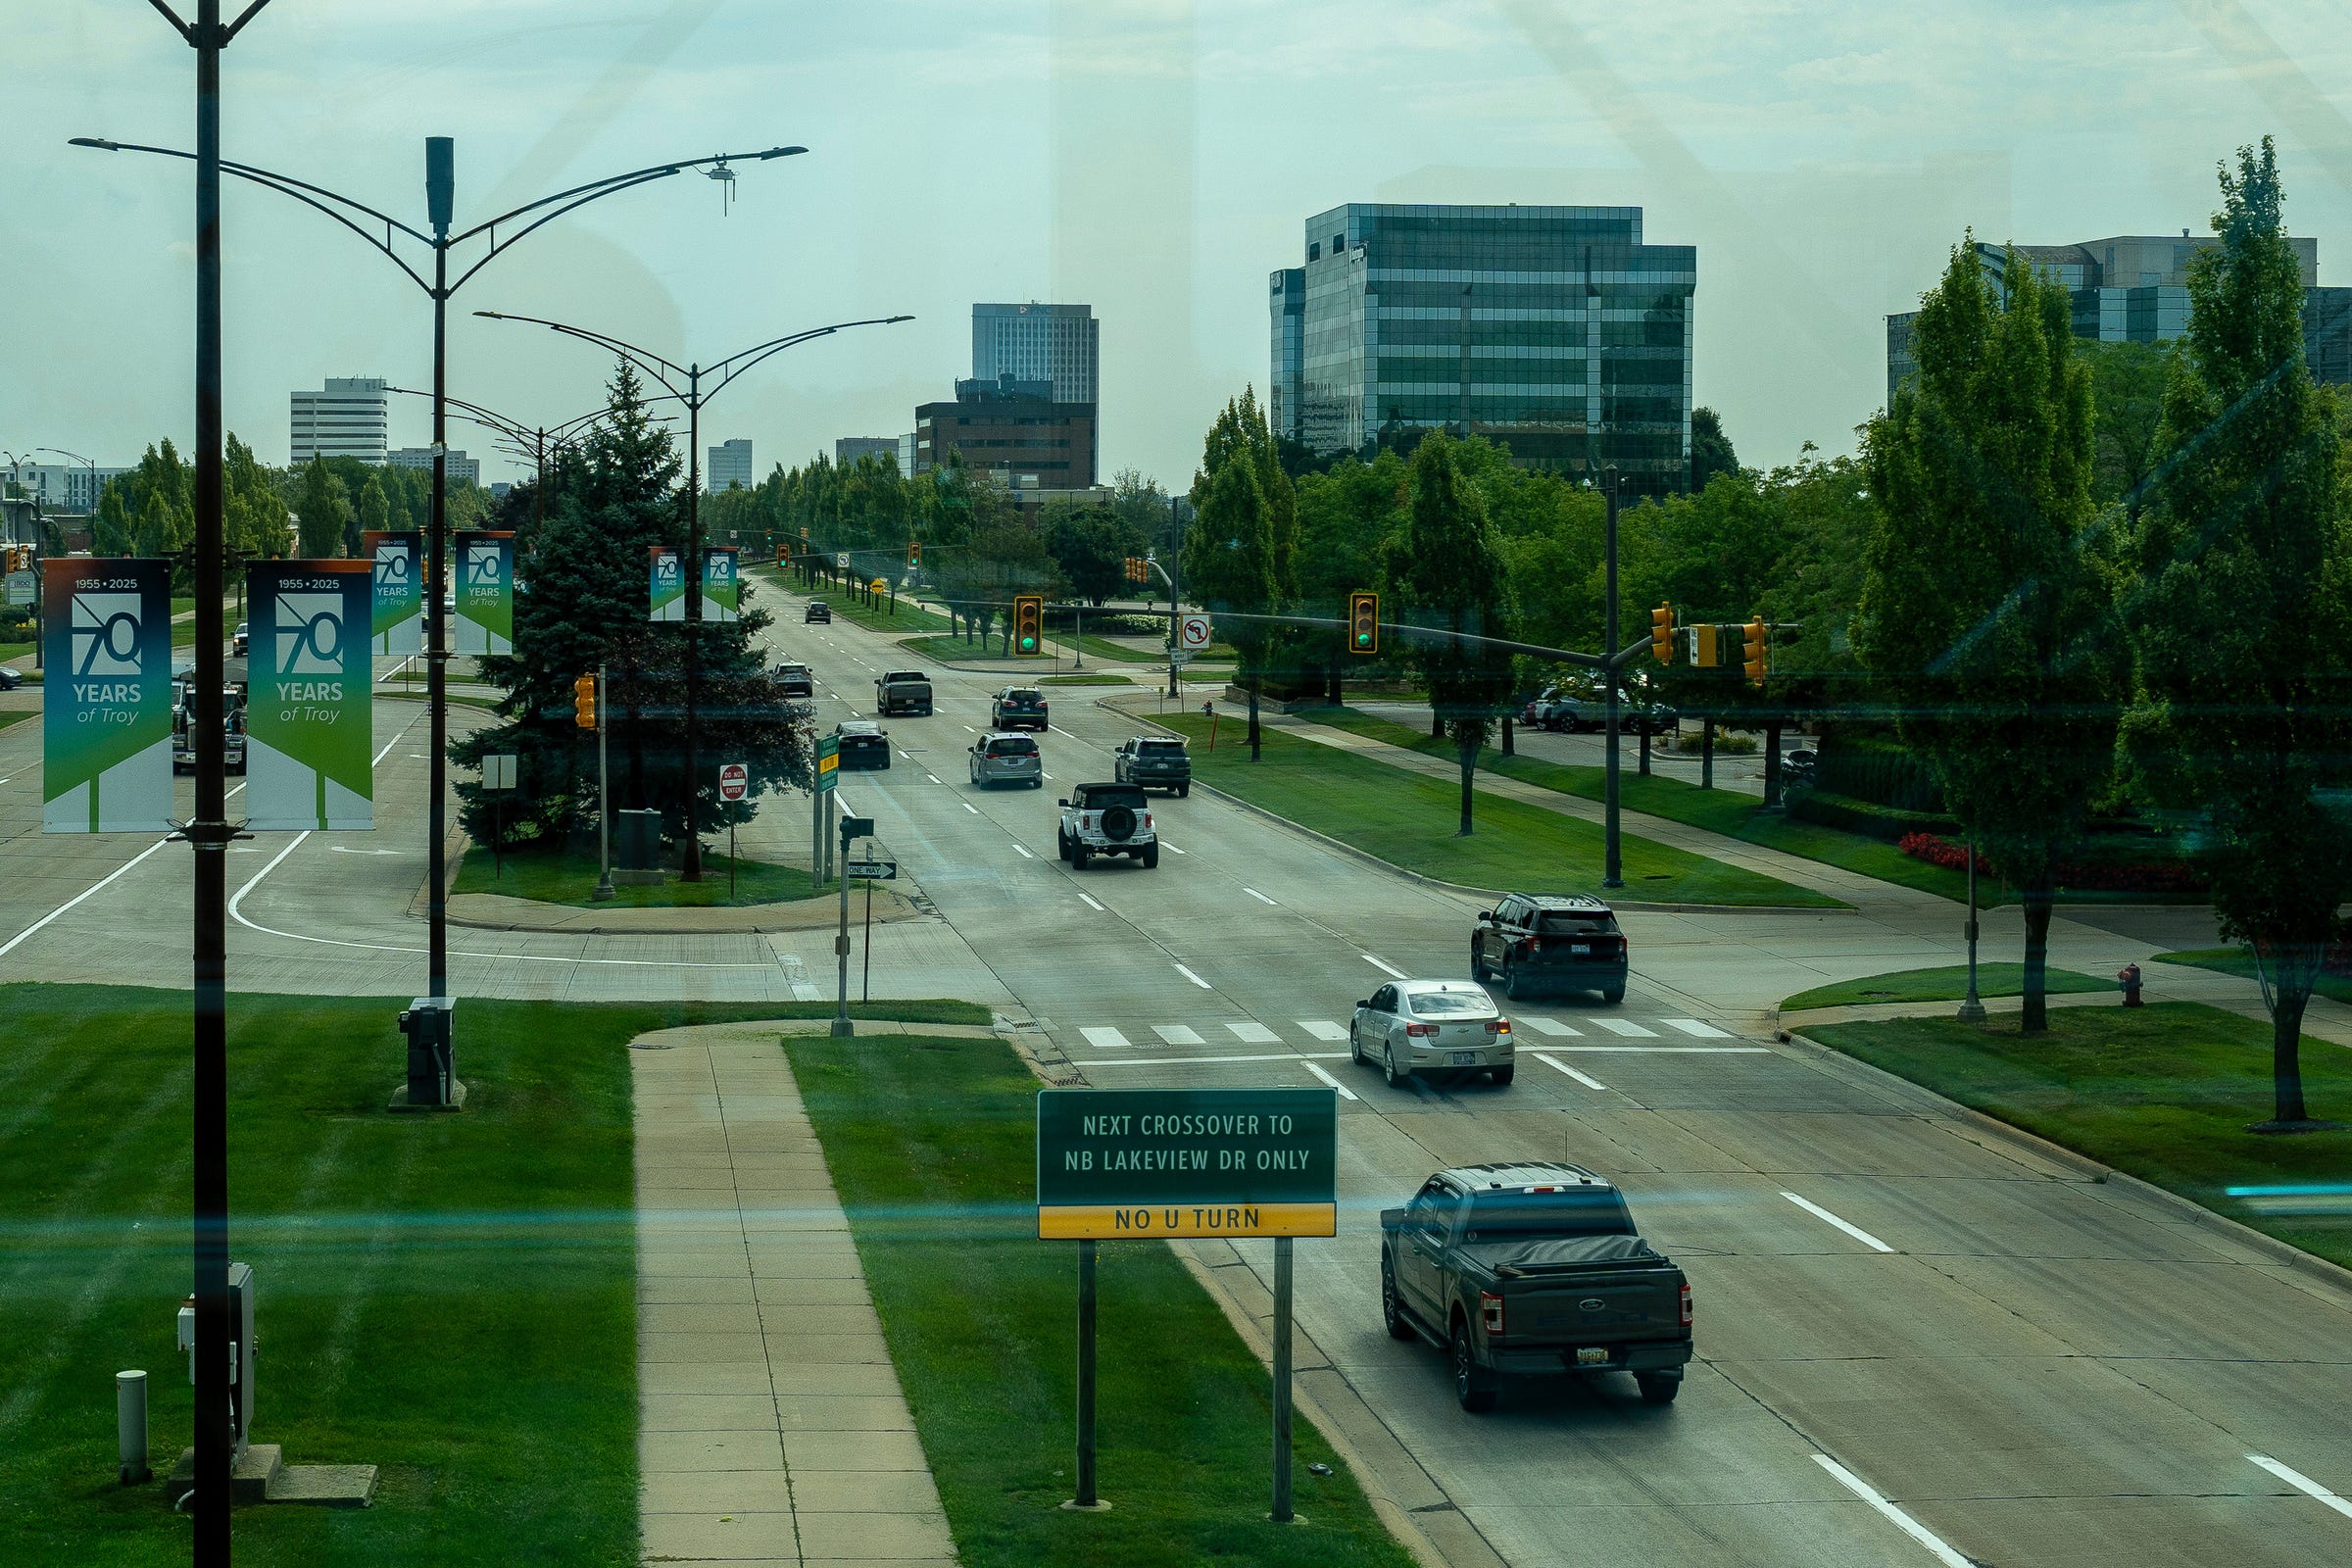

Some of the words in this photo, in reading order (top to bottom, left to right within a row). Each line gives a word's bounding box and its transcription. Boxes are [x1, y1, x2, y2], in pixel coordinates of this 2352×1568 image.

[1029, 306, 1052, 315] PNC
[376, 555, 408, 583] 70
[468, 555, 500, 583] 70
[659, 561, 677, 578] 70
[710, 561, 729, 578] 70
[74, 578, 100, 589] 1955
[109, 578, 137, 589] 2025
[278, 578, 304, 589] 1955
[312, 578, 340, 589] 2025
[376, 587, 409, 596] YEARS
[468, 587, 500, 597] YEARS
[389, 598, 407, 607] Troy
[481, 598, 498, 607] Troy
[73, 612, 141, 675] 70
[276, 611, 343, 673] 70
[73, 684, 141, 703] YEARS
[275, 682, 343, 702] YEARS
[76, 708, 97, 723] of
[101, 708, 139, 726] Troy
[280, 707, 300, 721] of
[304, 707, 340, 725] Troy
[1083, 1115, 1131, 1136] NEXT
[1141, 1114, 1259, 1135] CROSSOVER
[1268, 1115, 1293, 1135] TO
[1065, 1151, 1093, 1171] NB
[1103, 1150, 1208, 1170] LAKEVIEW
[1219, 1150, 1246, 1170] DR
[1256, 1150, 1309, 1170] ONLY
[1115, 1209, 1151, 1229] NO
[1165, 1209, 1179, 1229] U
[1193, 1208, 1259, 1228] TURN
